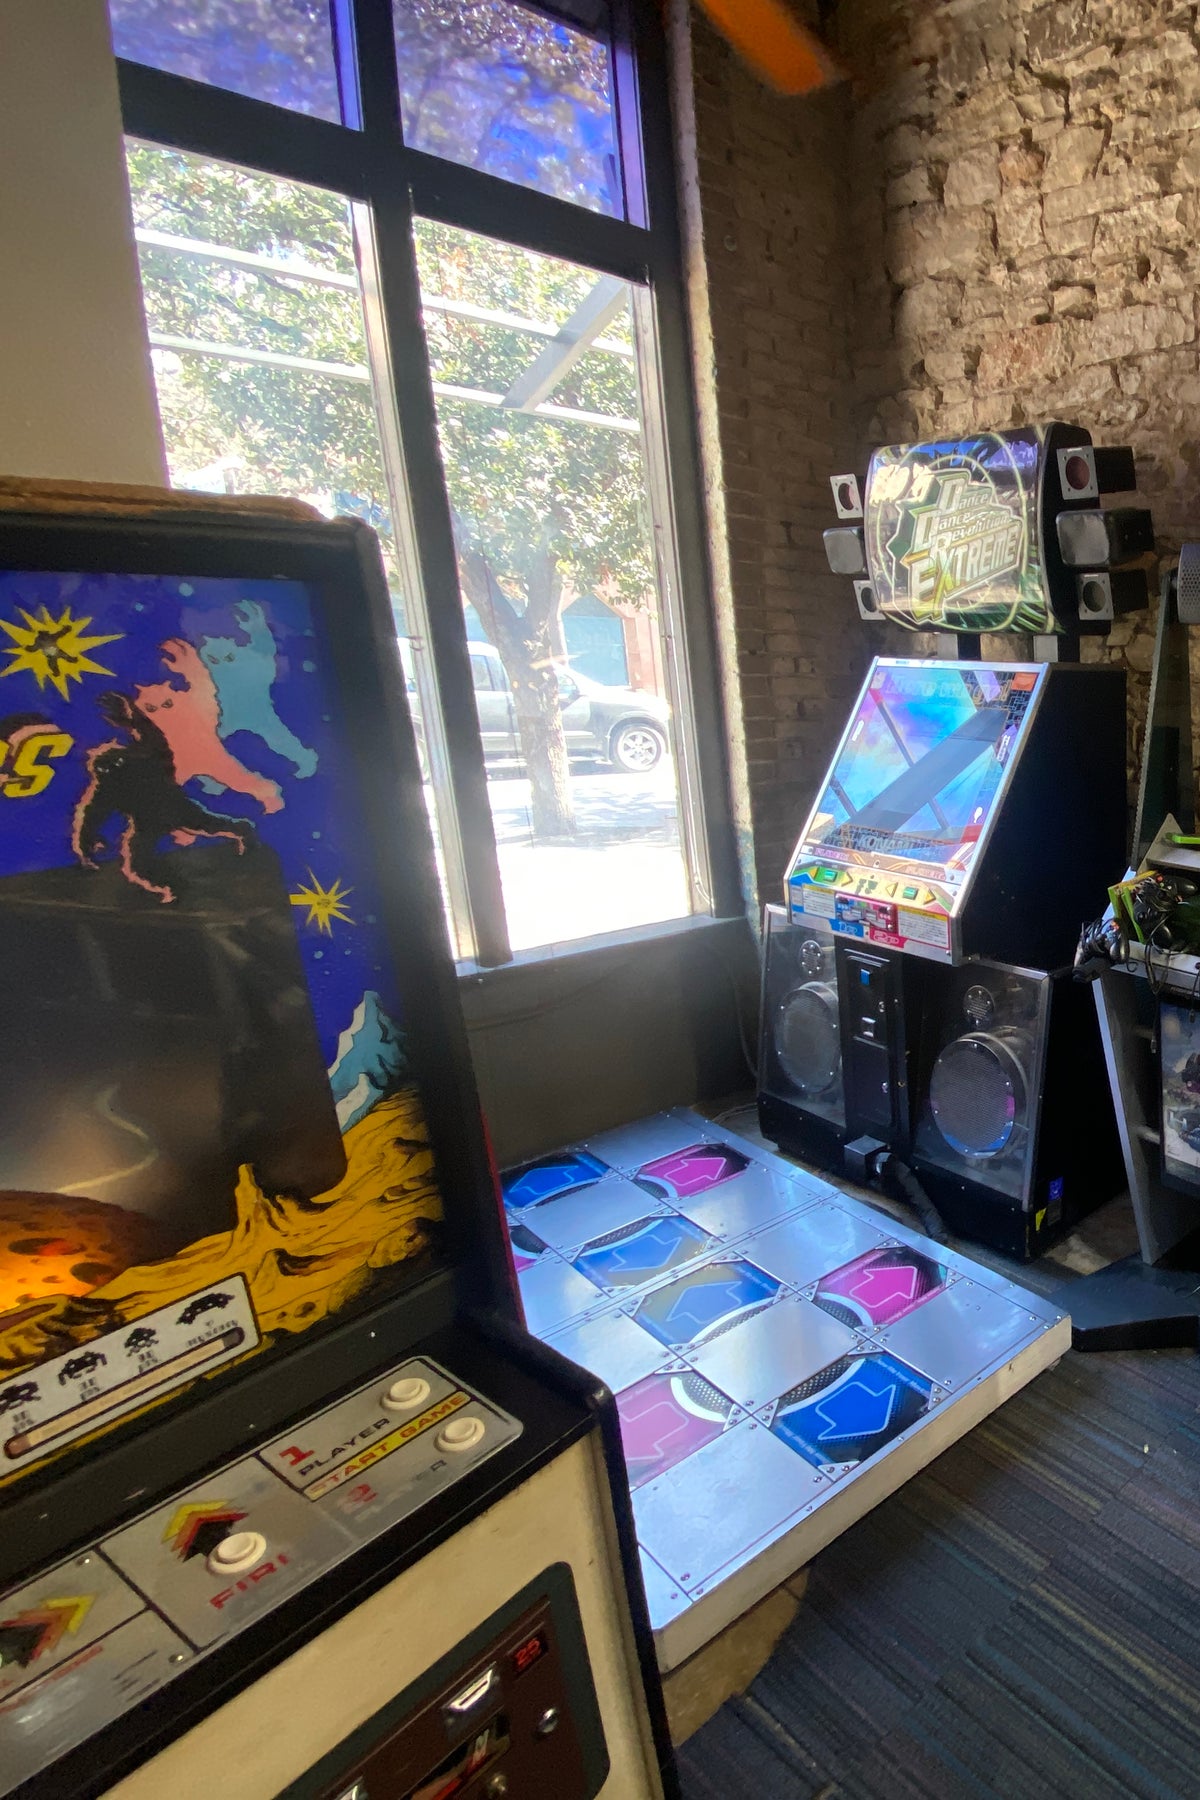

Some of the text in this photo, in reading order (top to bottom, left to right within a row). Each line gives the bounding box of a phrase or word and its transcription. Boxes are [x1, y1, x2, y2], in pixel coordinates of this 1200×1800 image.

[936, 477, 990, 515] Dance
[911, 508, 971, 552] Dance
[909, 525, 1021, 621] EXTREME
[279, 1445, 315, 1466] 1
[298, 1417, 391, 1477] PLAYER
[309, 1441, 389, 1494] START
[399, 1393, 465, 1439] GAME
